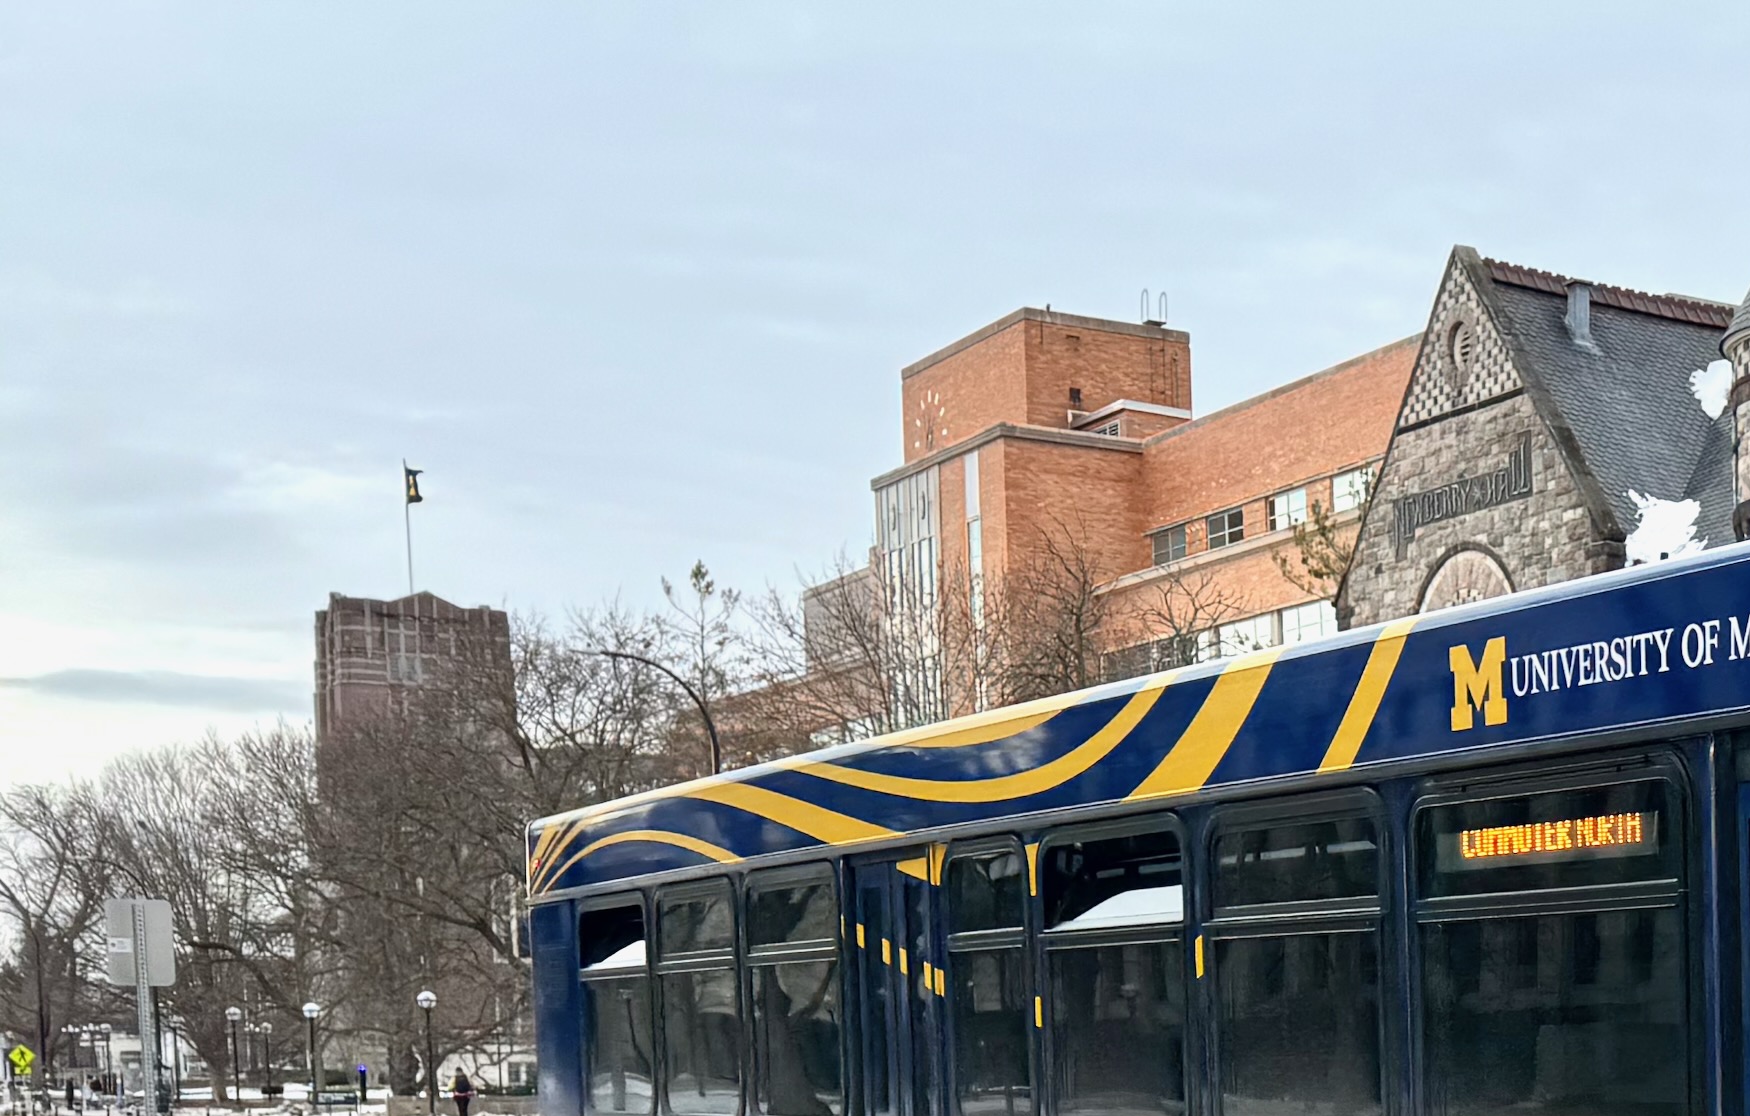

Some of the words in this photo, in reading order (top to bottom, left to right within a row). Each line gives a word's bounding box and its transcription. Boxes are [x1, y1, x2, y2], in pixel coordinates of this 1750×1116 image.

[1484, 434, 1531, 504] HALL
[1449, 635, 1509, 732] M
[1510, 627, 1674, 697] UNIVERSITY
[1681, 619, 1721, 668] OF
